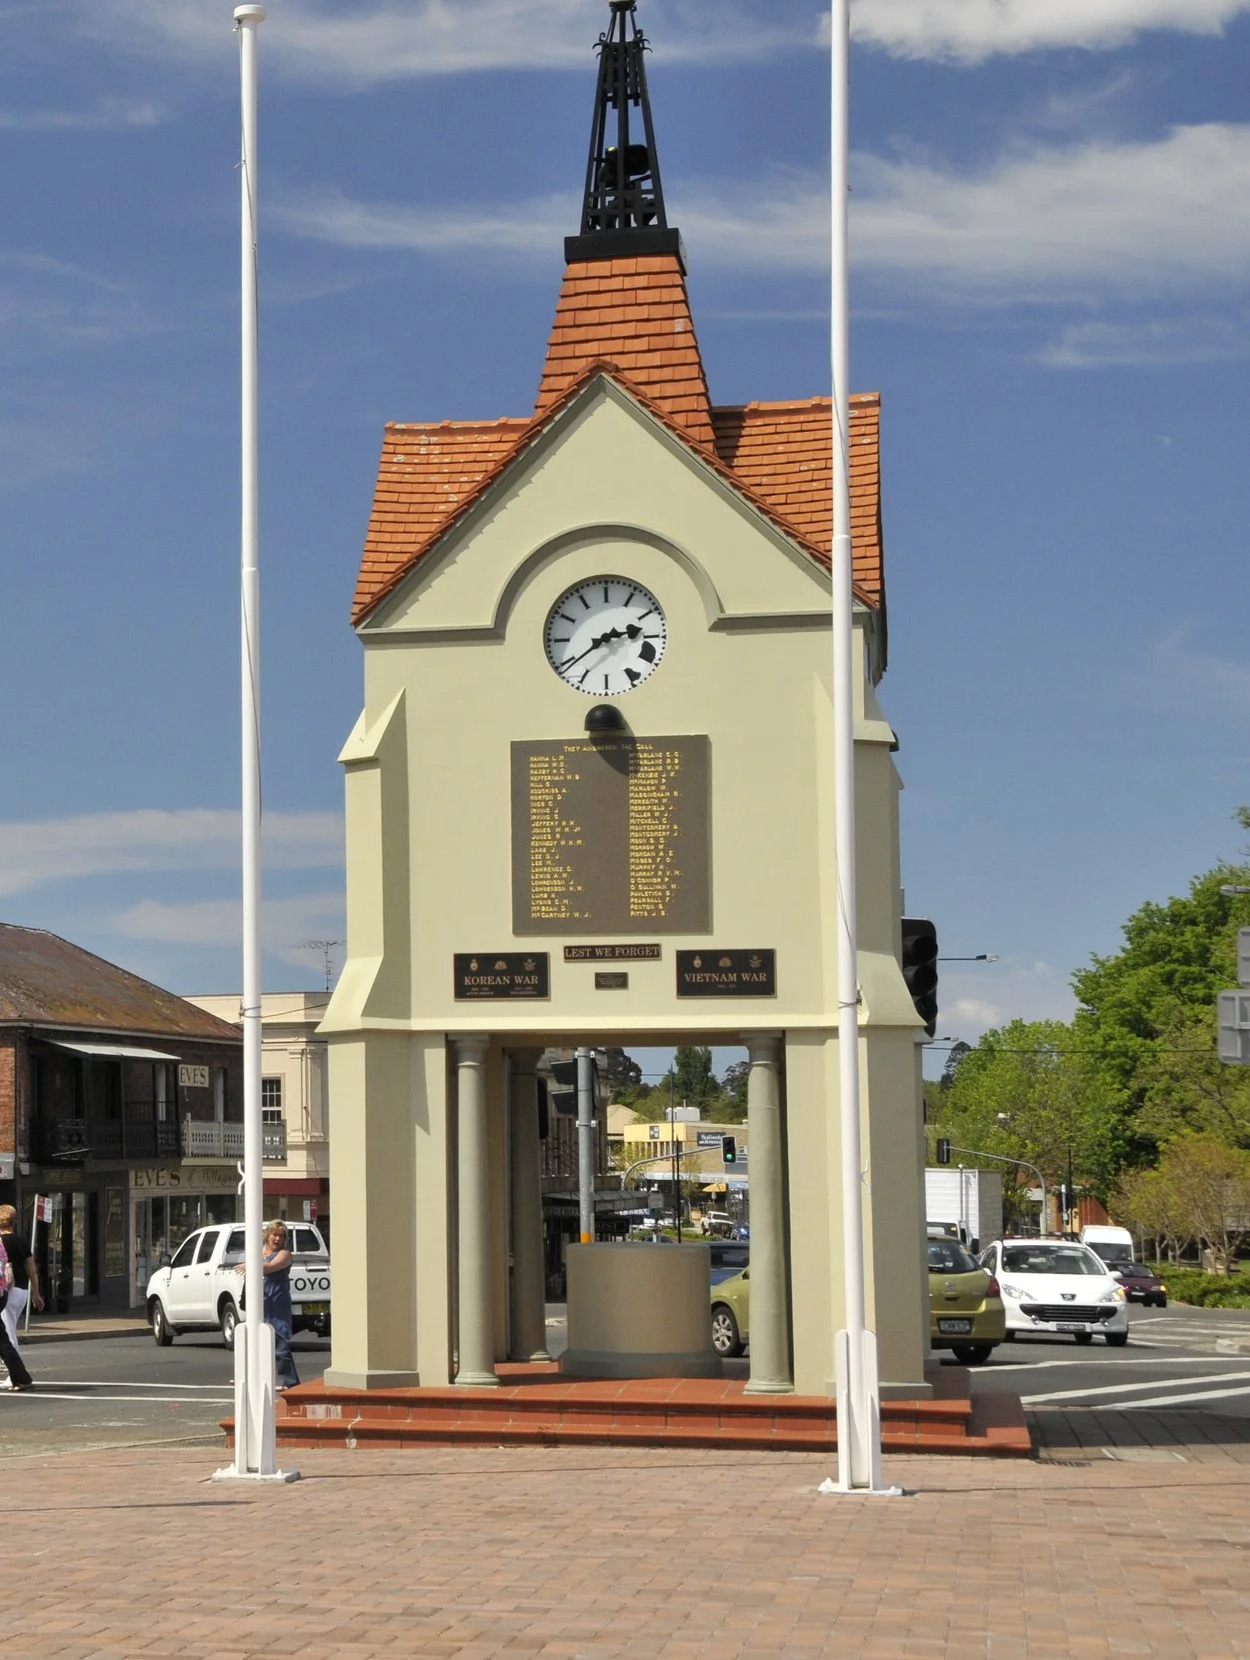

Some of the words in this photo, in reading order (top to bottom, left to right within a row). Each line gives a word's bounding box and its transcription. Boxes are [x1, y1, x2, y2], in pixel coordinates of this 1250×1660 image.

[565, 948, 592, 957] LEST
[595, 947, 612, 957] WE
[615, 946, 659, 956] FORGET
[464, 975, 510, 985] KOREAN
[514, 975, 538, 984] WAR
[684, 973, 737, 982] VIETNAM
[741, 972, 767, 981] WAR
[290, 1277, 331, 1291] OYO
